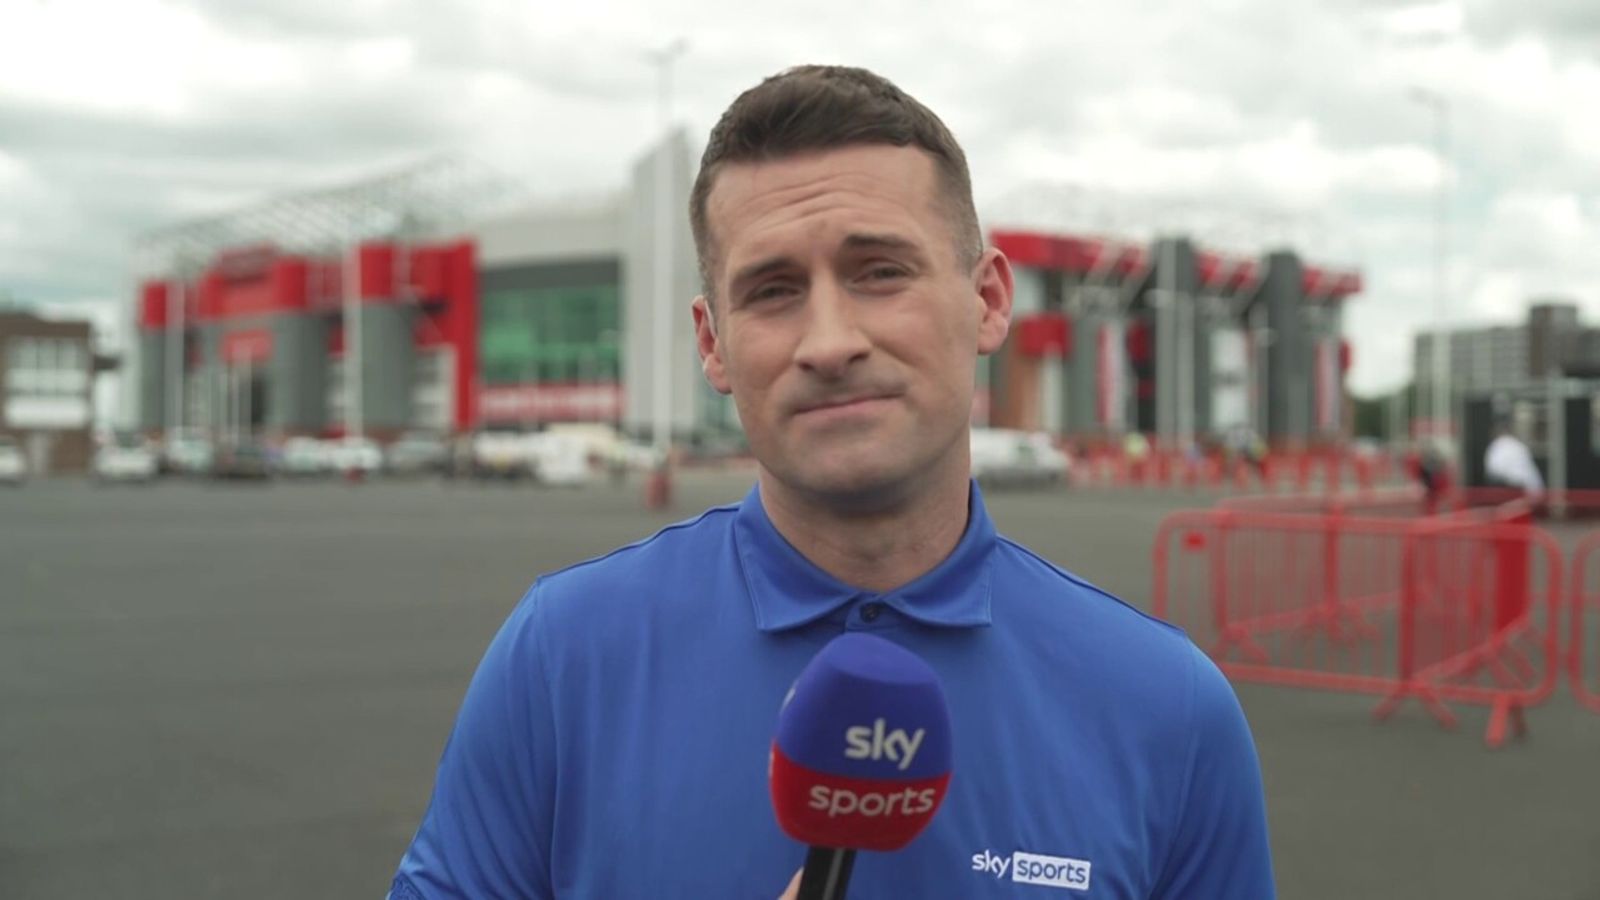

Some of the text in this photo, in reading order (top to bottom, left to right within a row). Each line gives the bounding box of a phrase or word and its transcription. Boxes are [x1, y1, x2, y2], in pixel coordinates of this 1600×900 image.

[845, 717, 925, 770] sky
[808, 785, 935, 817] sports
[972, 849, 1086, 883] sky sports
